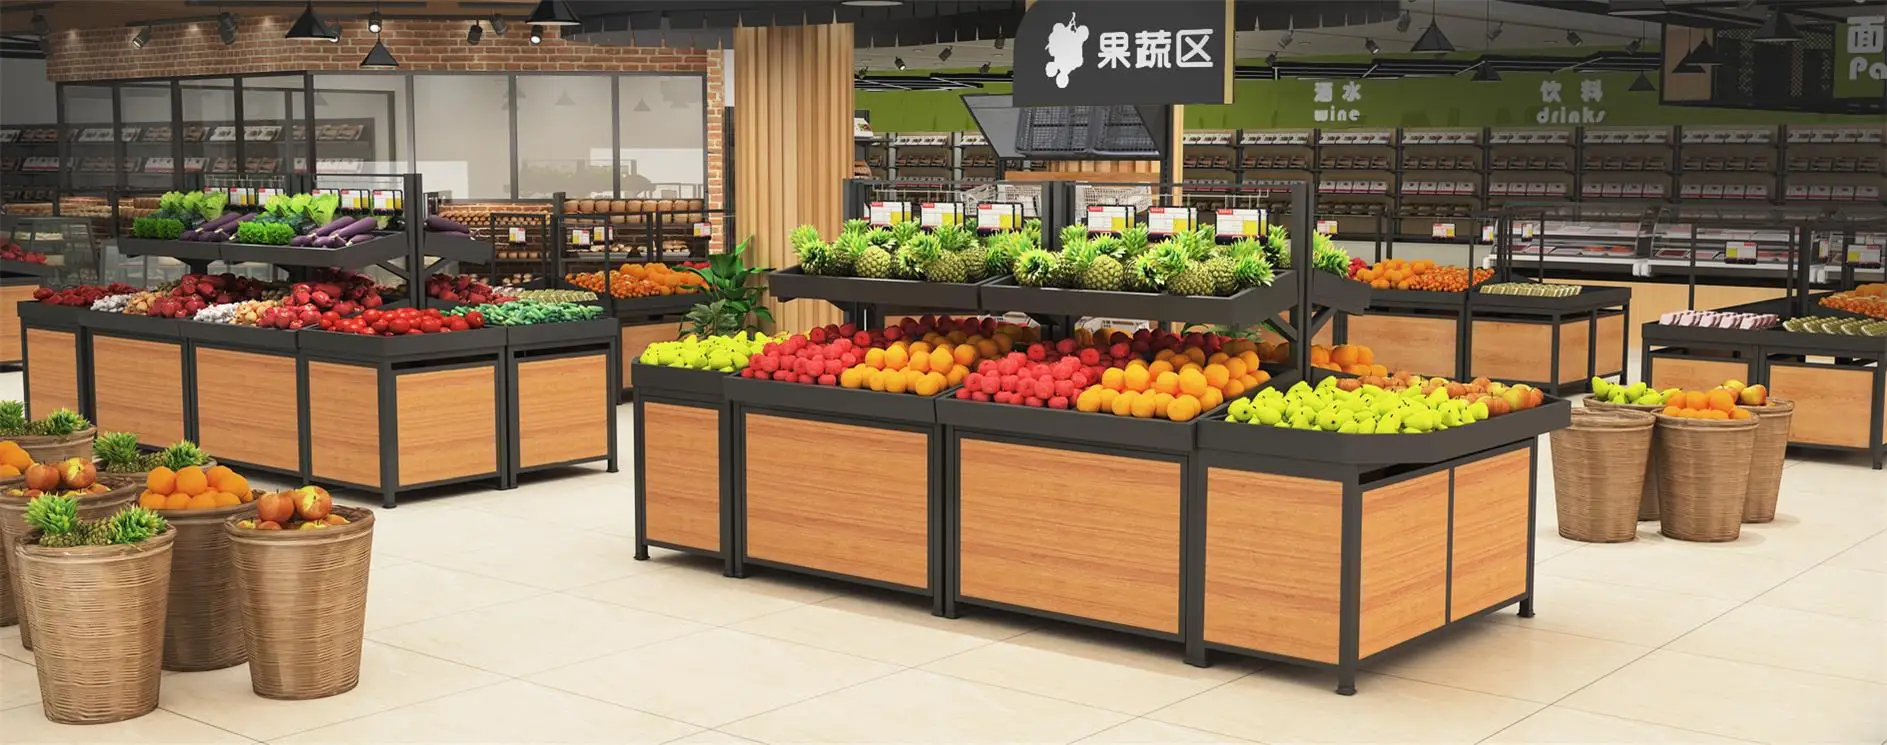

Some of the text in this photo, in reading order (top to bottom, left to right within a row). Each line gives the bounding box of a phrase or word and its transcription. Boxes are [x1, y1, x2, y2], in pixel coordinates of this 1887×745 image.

[1847, 16, 1885, 53] 面
[1097, 28, 1213, 69] 果蔬区
[1314, 105, 1360, 121] wine
[1536, 106, 1606, 123] drinks
